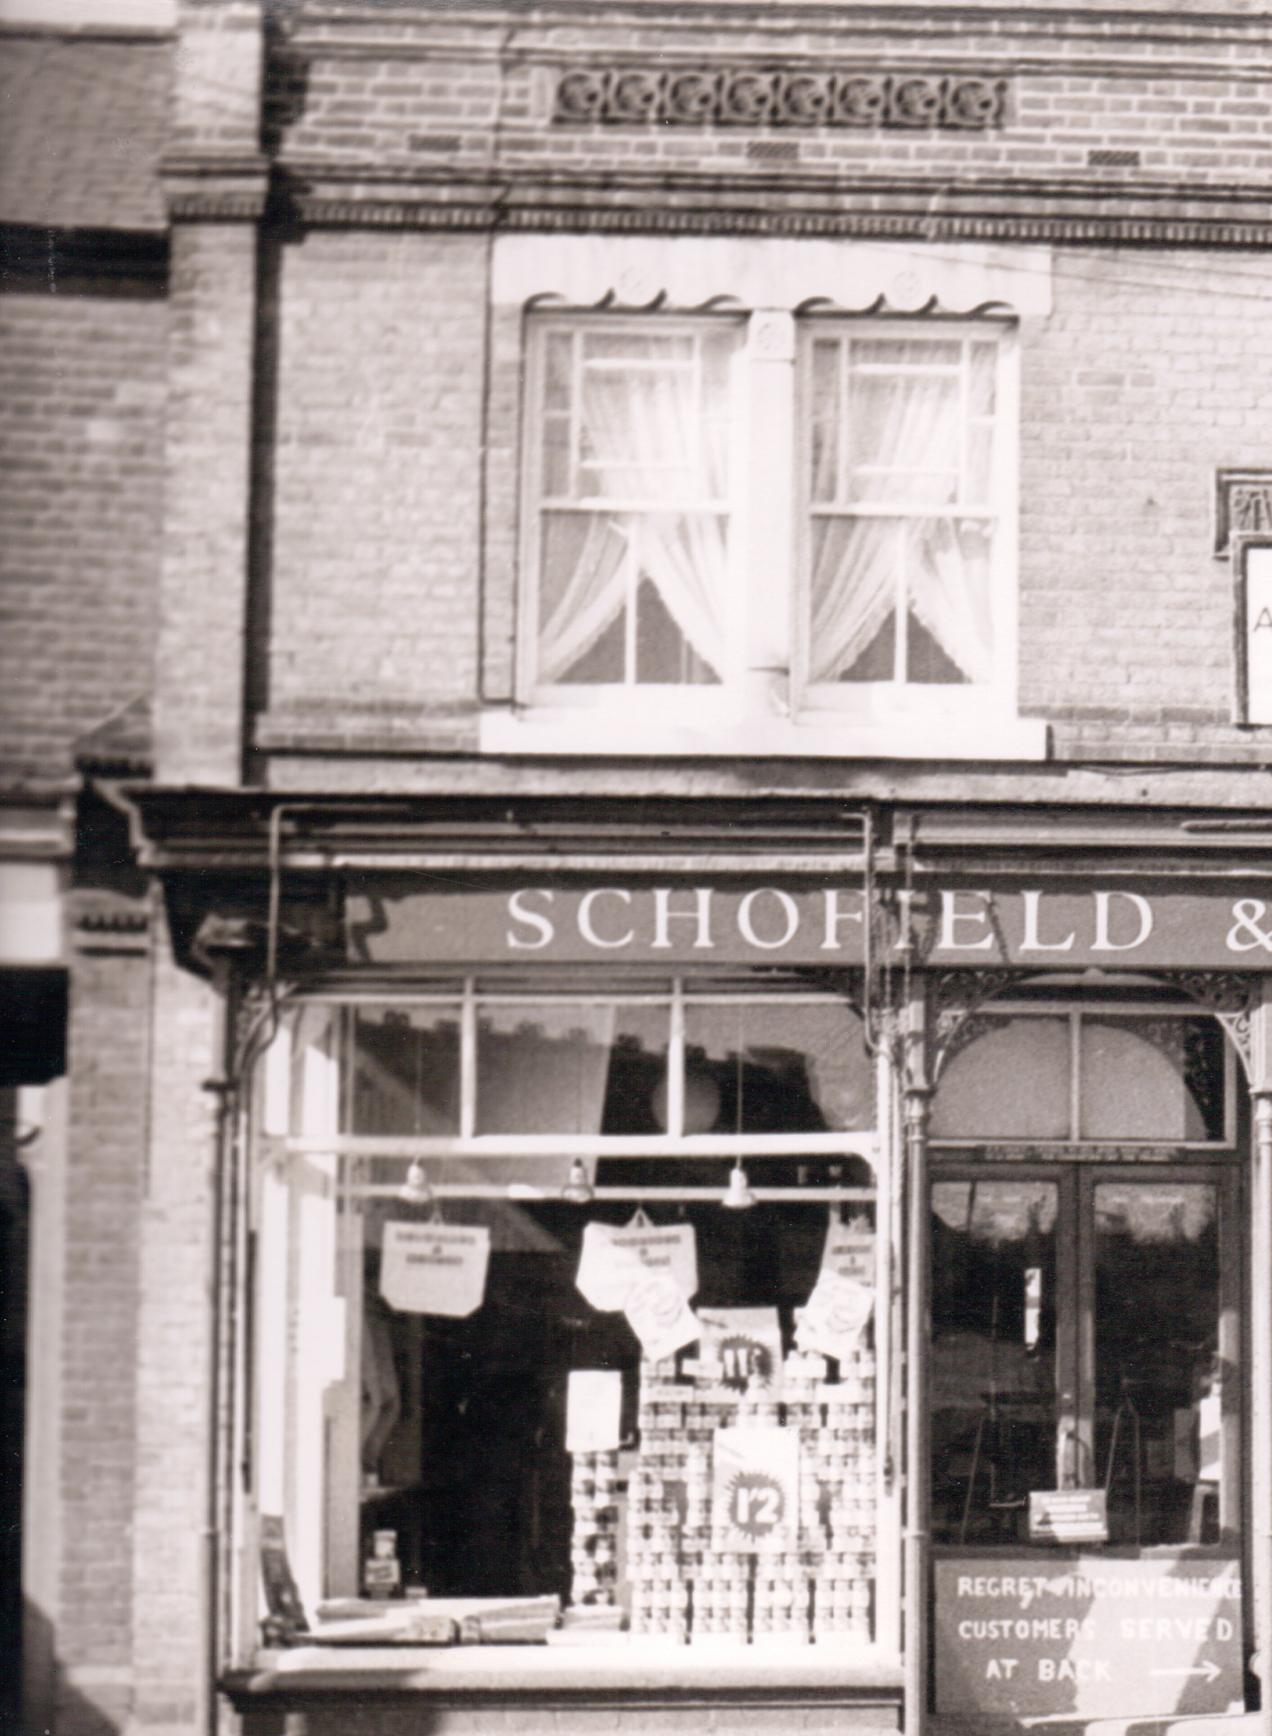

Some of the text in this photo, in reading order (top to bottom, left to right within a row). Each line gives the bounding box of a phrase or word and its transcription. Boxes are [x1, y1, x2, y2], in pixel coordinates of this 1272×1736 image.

[504, 887, 1155, 952] SCHOFIELD
[956, 1575, 1046, 1599] REGRET
[957, 1617, 1234, 1642] CUSTOMERS SERVED
[984, 1657, 1113, 1682] AT BACK
